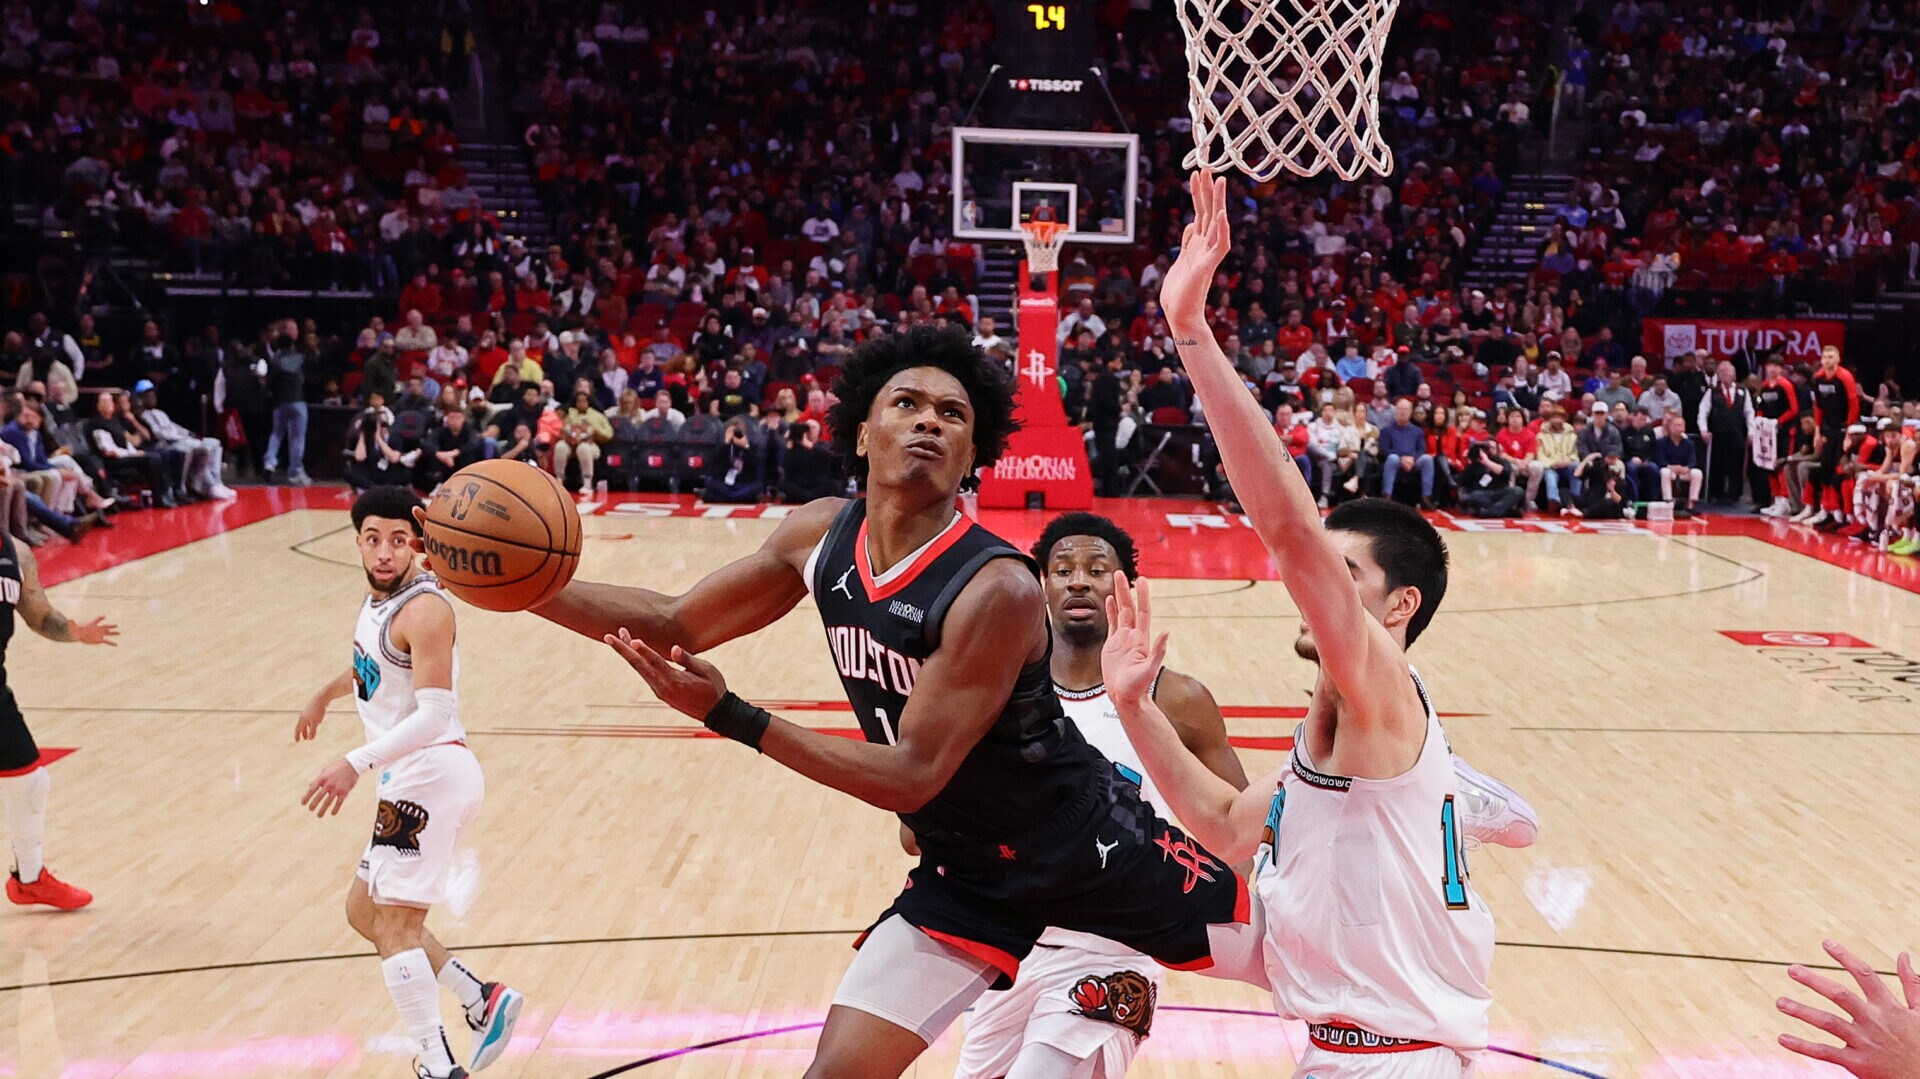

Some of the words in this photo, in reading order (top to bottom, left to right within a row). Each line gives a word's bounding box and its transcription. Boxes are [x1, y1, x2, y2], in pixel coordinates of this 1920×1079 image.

[1027, 4, 1066, 31] 7.4
[1028, 79, 1084, 92] TISSOT
[424, 532, 505, 576] Wilson
